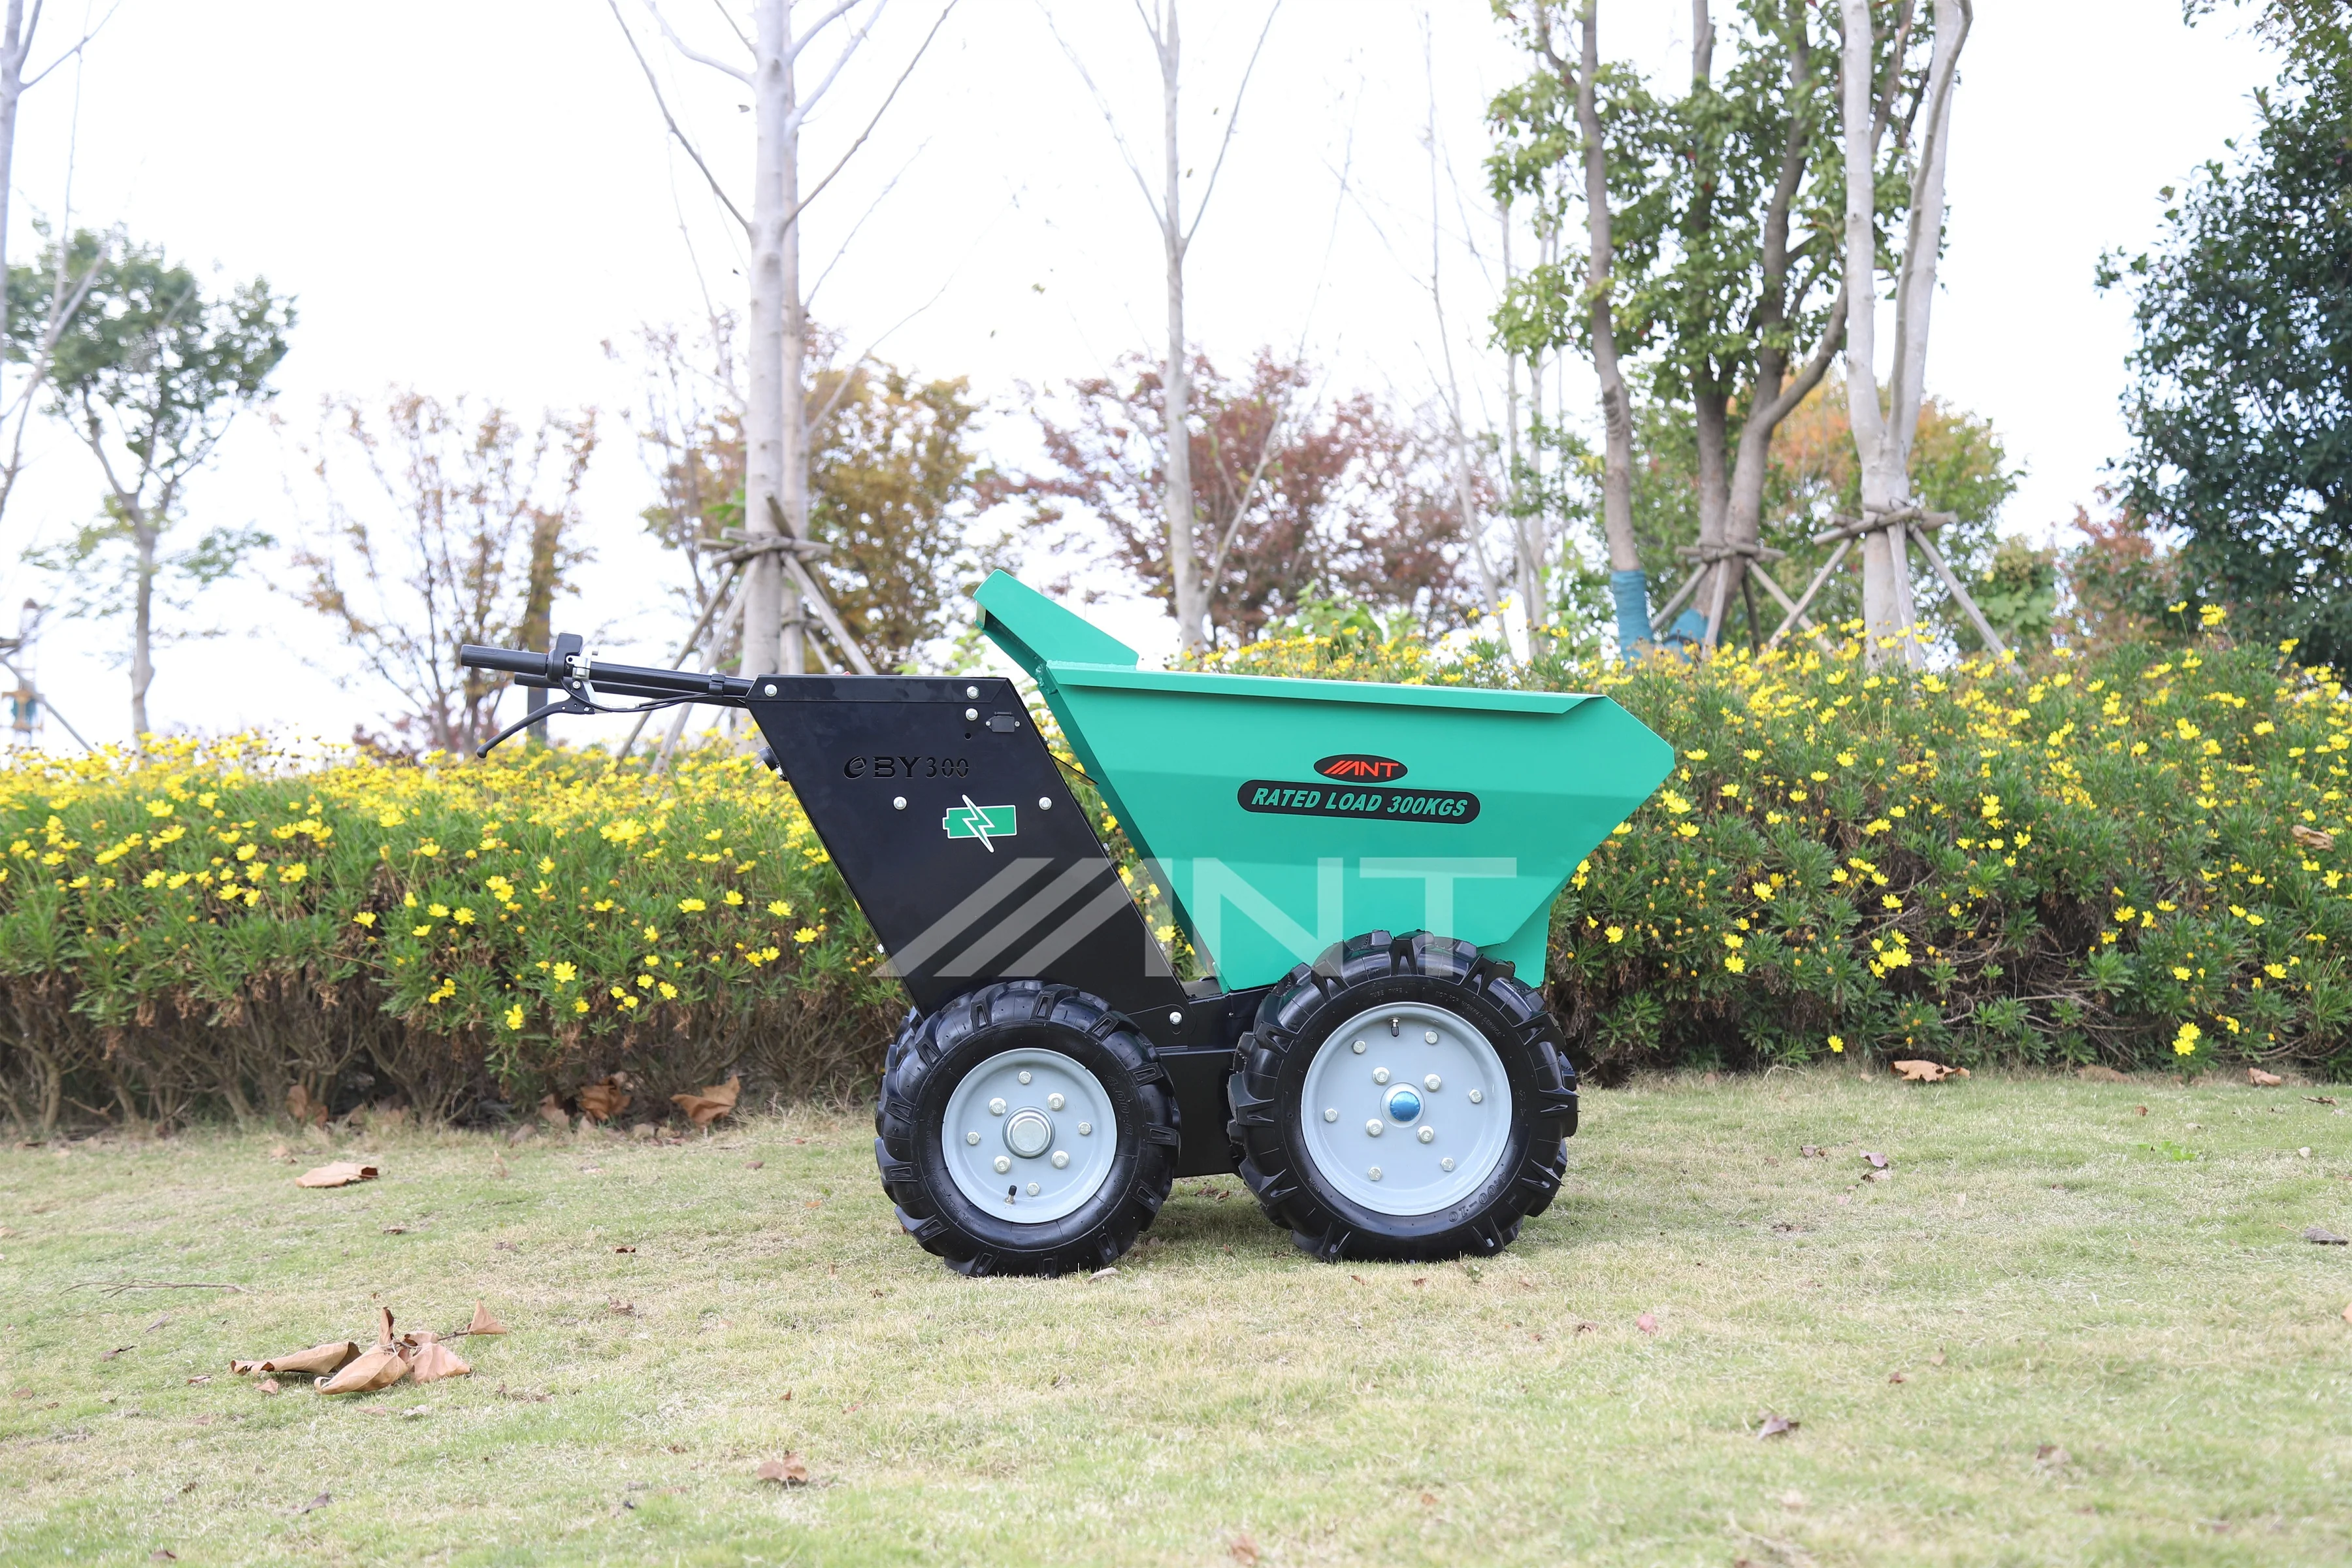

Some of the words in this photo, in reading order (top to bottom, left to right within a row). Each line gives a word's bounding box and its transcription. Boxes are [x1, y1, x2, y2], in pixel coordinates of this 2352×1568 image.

[1251, 788, 1321, 809] RATED
[1324, 792, 1382, 813] LOAD
[1386, 796, 1468, 817] 300KGS
[1481, 1015, 1503, 1037] SERVICE
